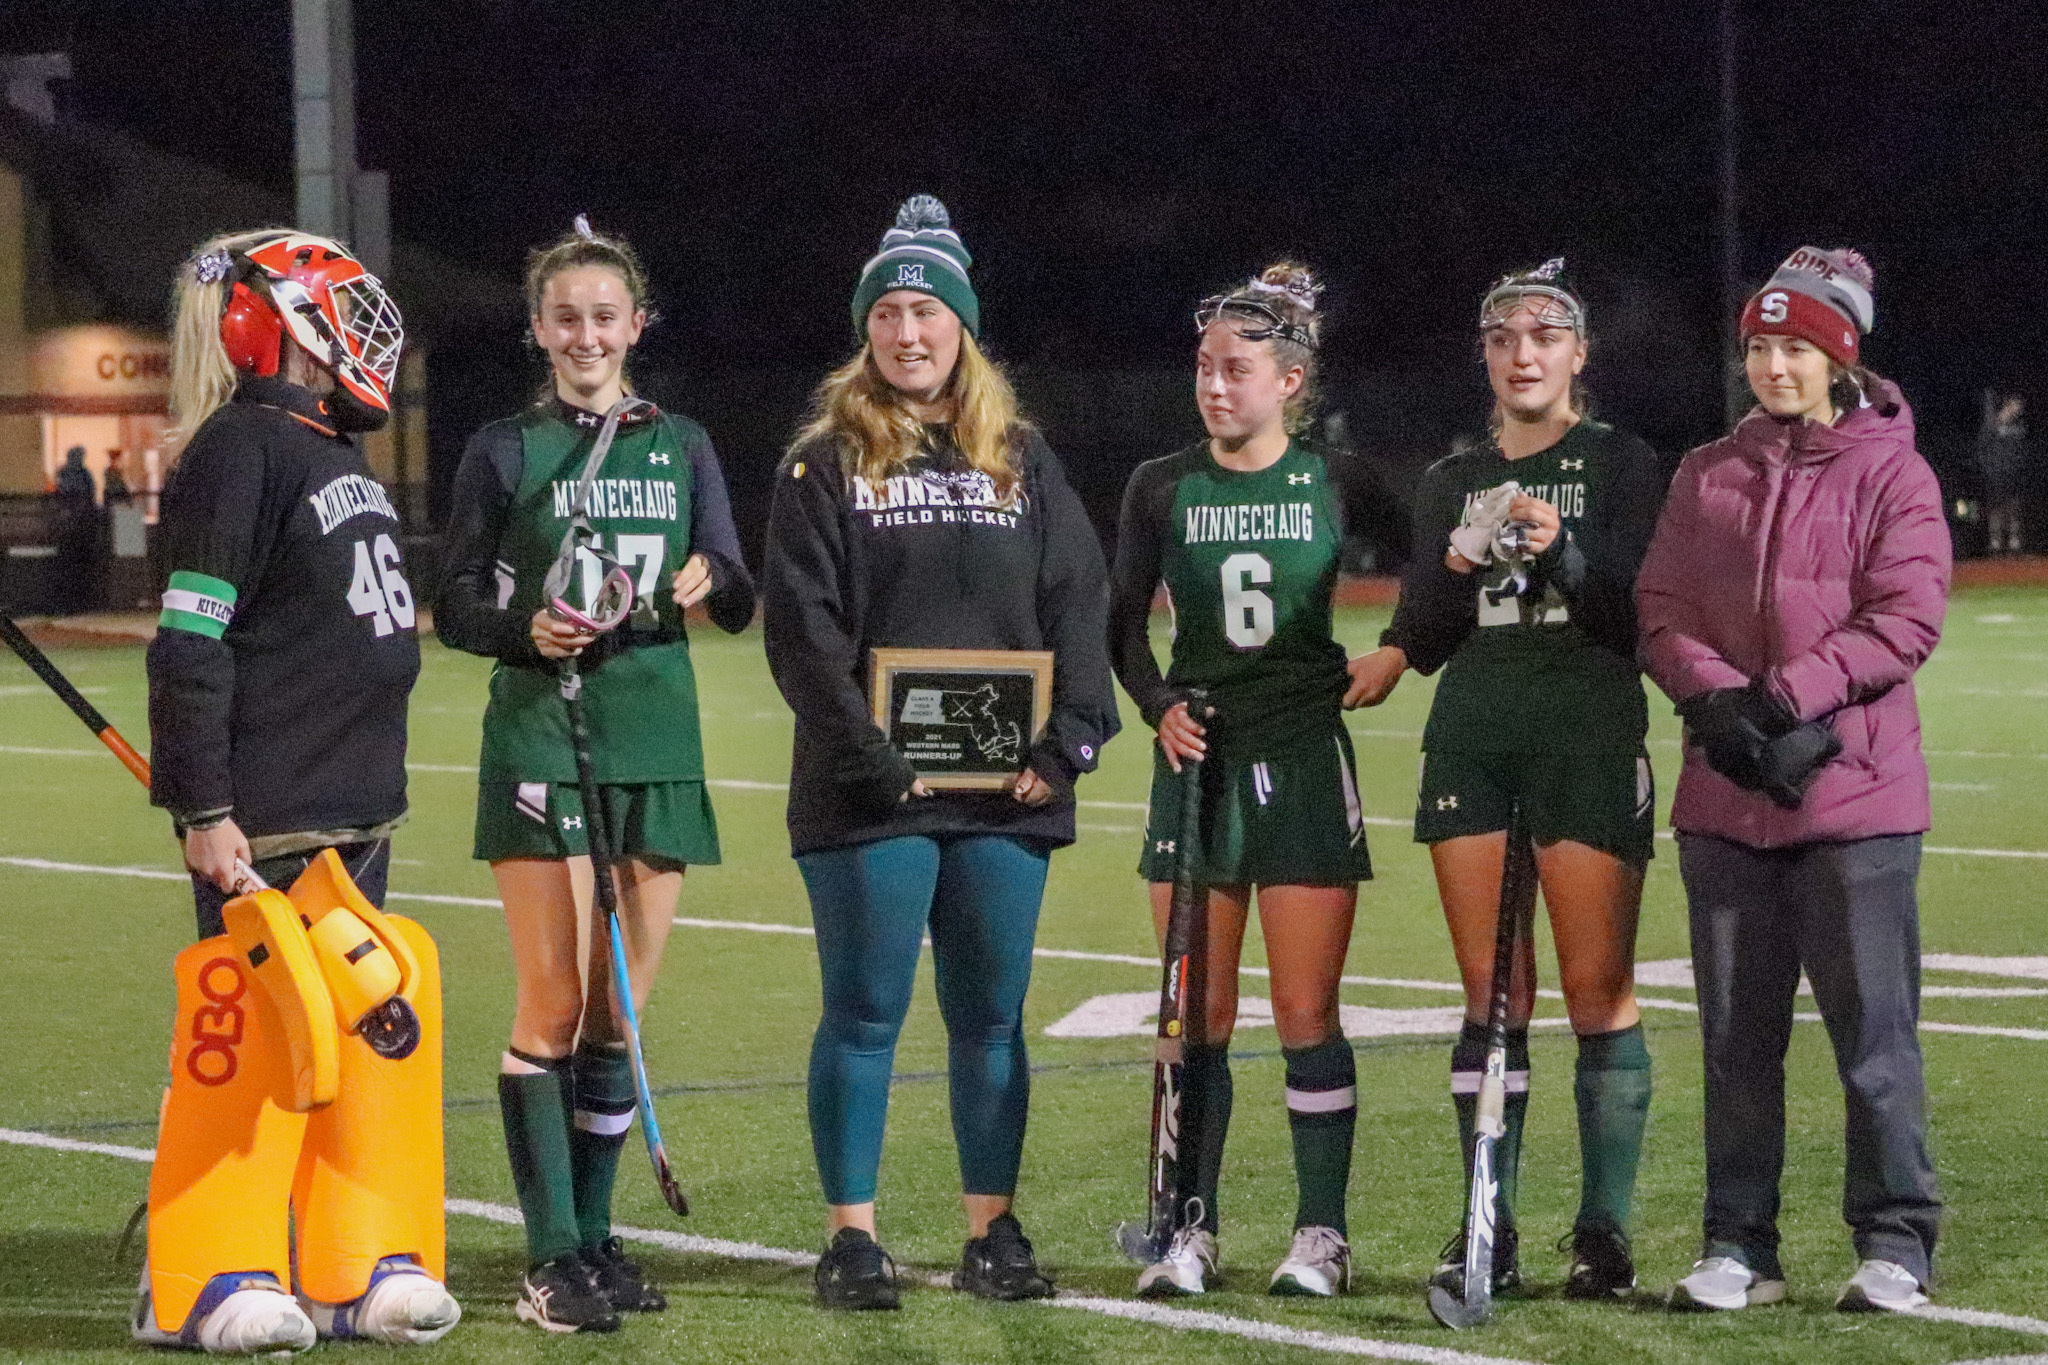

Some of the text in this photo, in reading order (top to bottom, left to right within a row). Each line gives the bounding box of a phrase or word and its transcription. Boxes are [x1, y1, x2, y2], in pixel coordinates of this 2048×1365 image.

[898, 264, 924, 281] M
[905, 281, 933, 289] HOCKEY
[1760, 292, 1789, 323] S
[309, 473, 398, 536] MINNECHAUG
[872, 509, 934, 528] FIELD
[1185, 502, 1313, 545] MINNECHAUG
[346, 533, 415, 638] 46
[574, 533, 664, 629] 17
[196, 597, 234, 622] APTAIN
[1220, 553, 1275, 648] 6
[903, 752, 962, 760] RUNNERS-UP
[906, 742, 939, 750] WESTERN
[186, 956, 247, 1087] OBO
